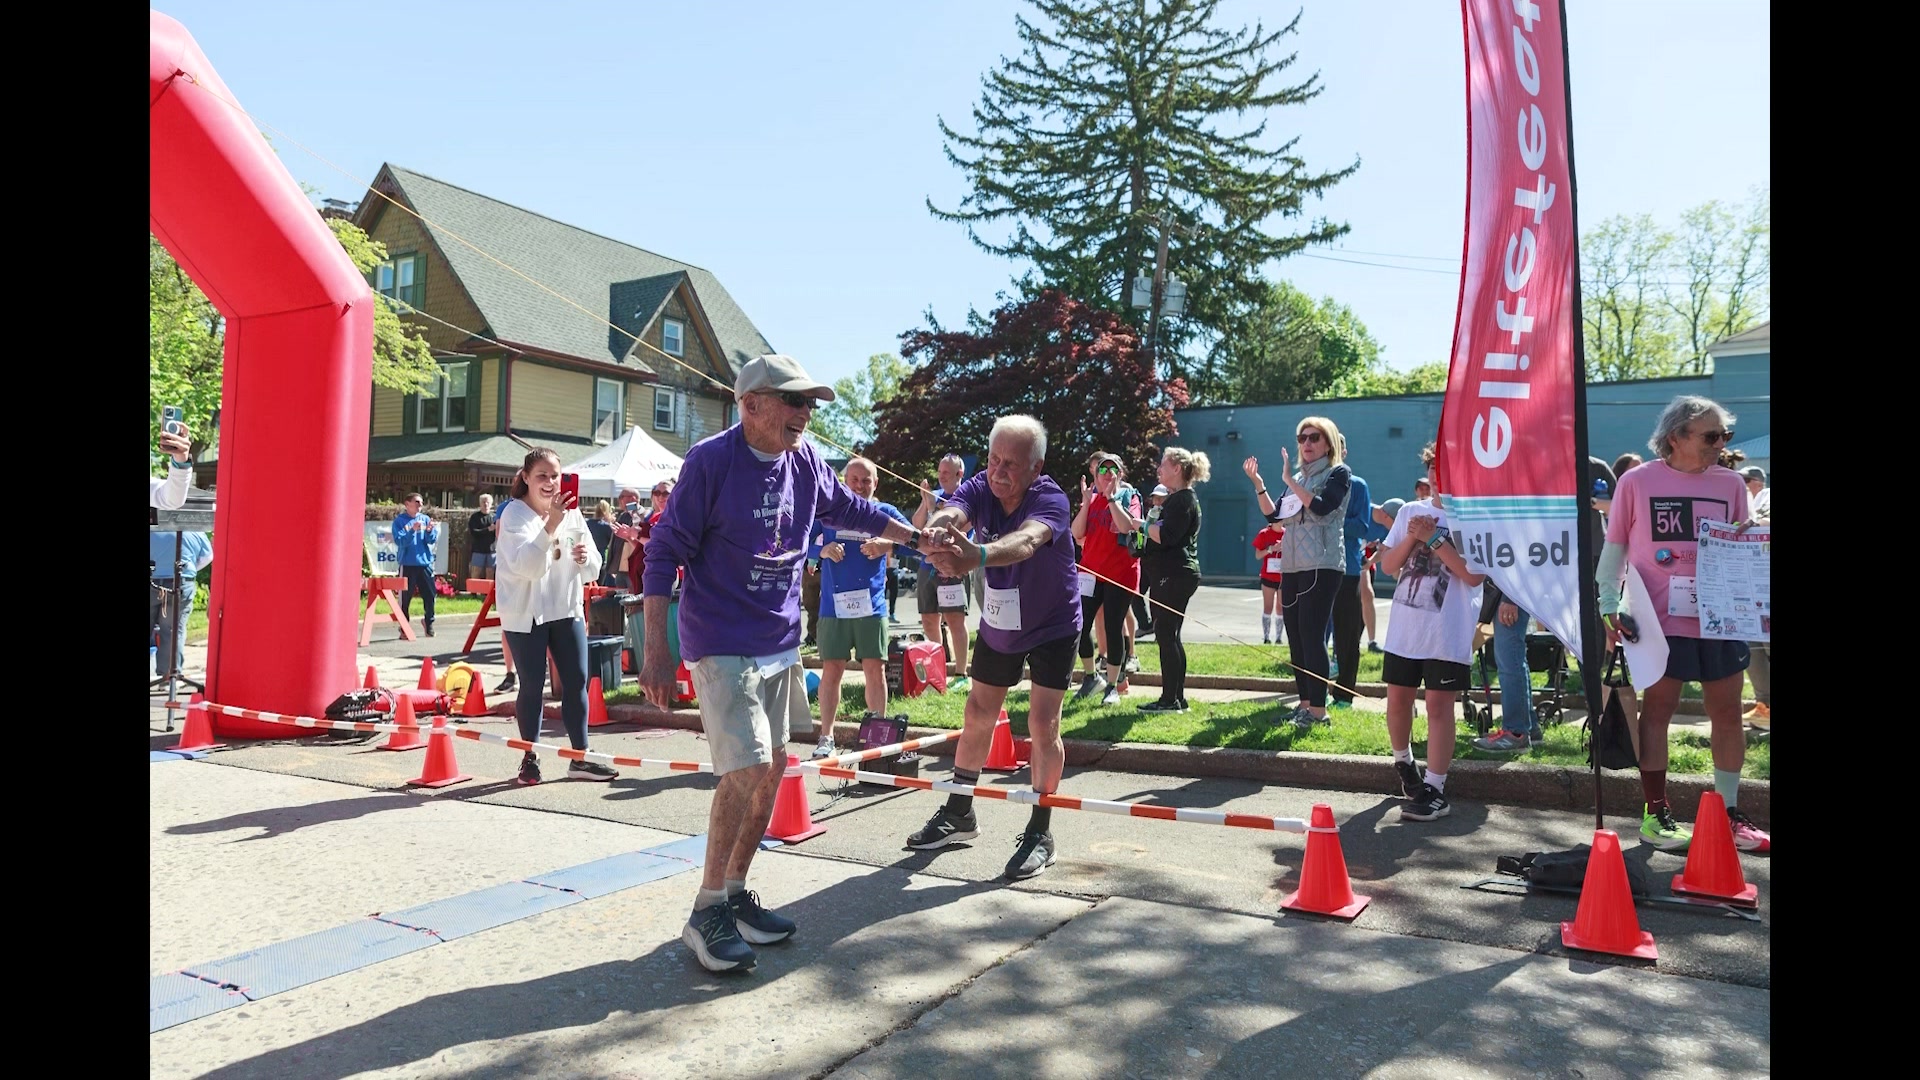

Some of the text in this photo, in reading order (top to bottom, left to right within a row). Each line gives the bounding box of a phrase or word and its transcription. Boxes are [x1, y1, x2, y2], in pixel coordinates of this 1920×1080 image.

[753, 509, 761, 518] 10
[1656, 511, 1683, 533] 5K
[846, 601, 860, 610] 462
